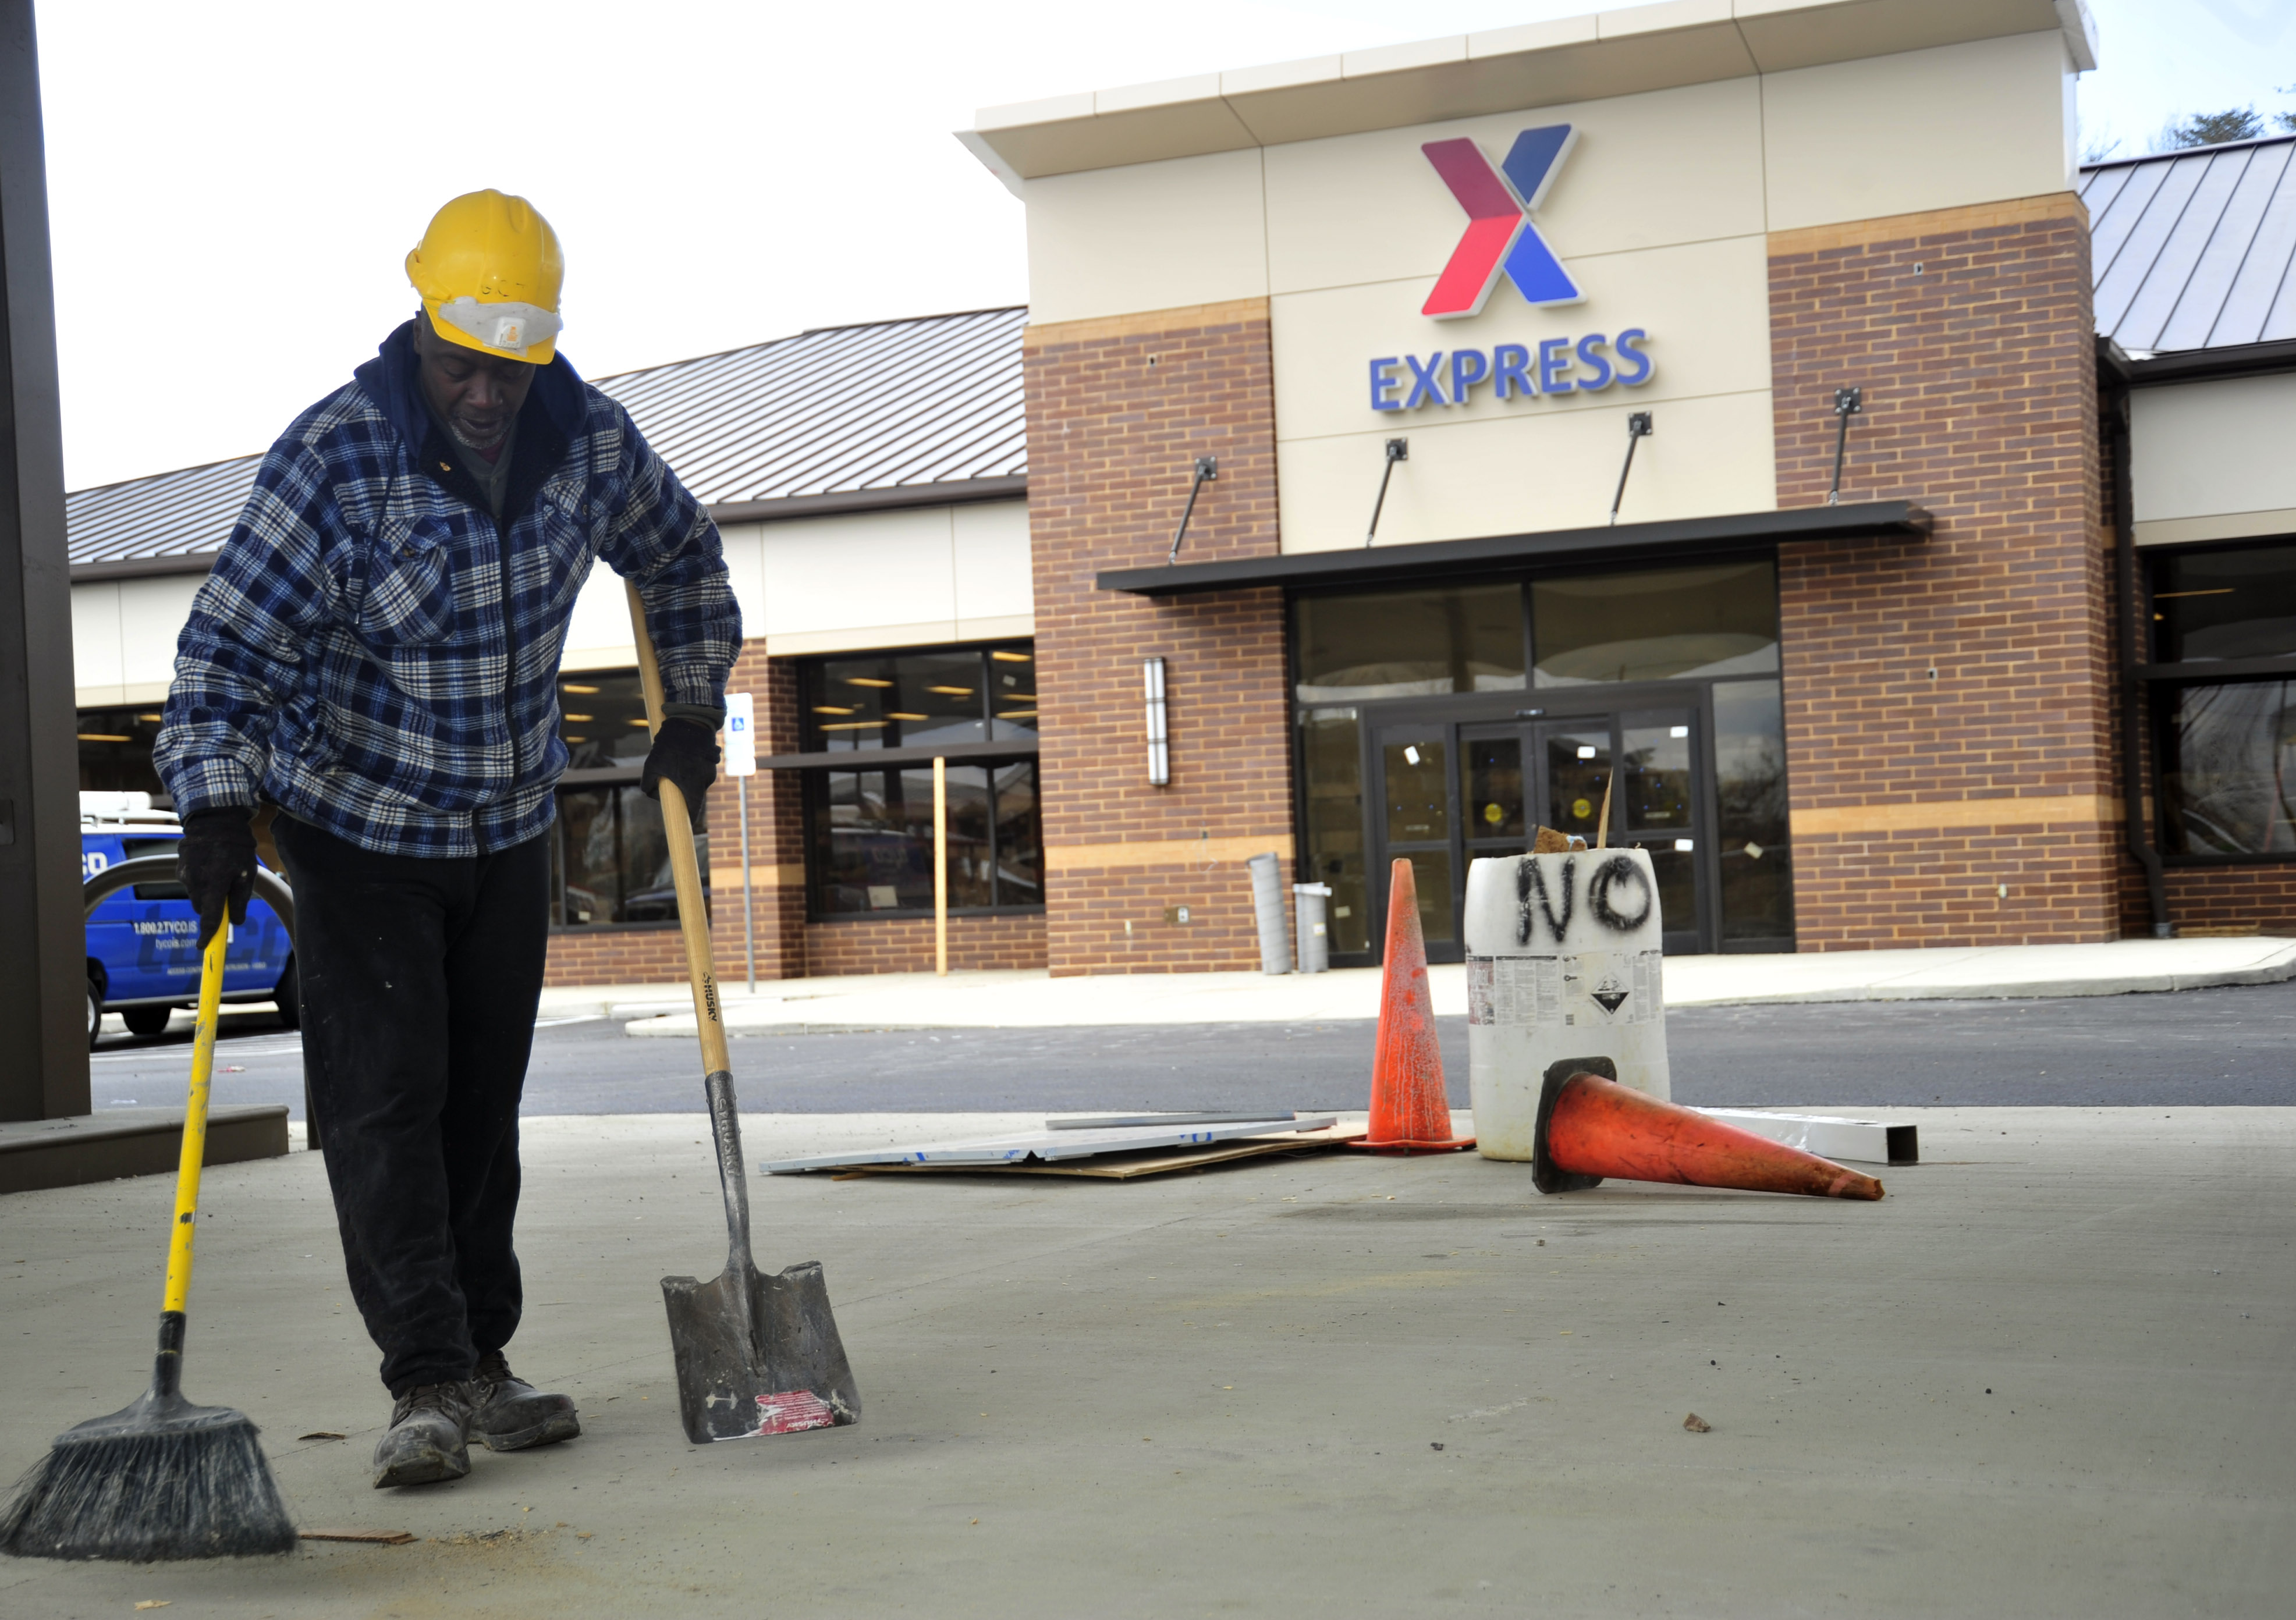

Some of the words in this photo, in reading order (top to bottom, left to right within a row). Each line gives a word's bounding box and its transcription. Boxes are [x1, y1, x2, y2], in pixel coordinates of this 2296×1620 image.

[1369, 328, 1655, 411] EXPRESS
[1516, 855, 1652, 946] NO
[704, 984, 717, 1022] HUSKY
[786, 1419, 818, 1429] HUSKY
